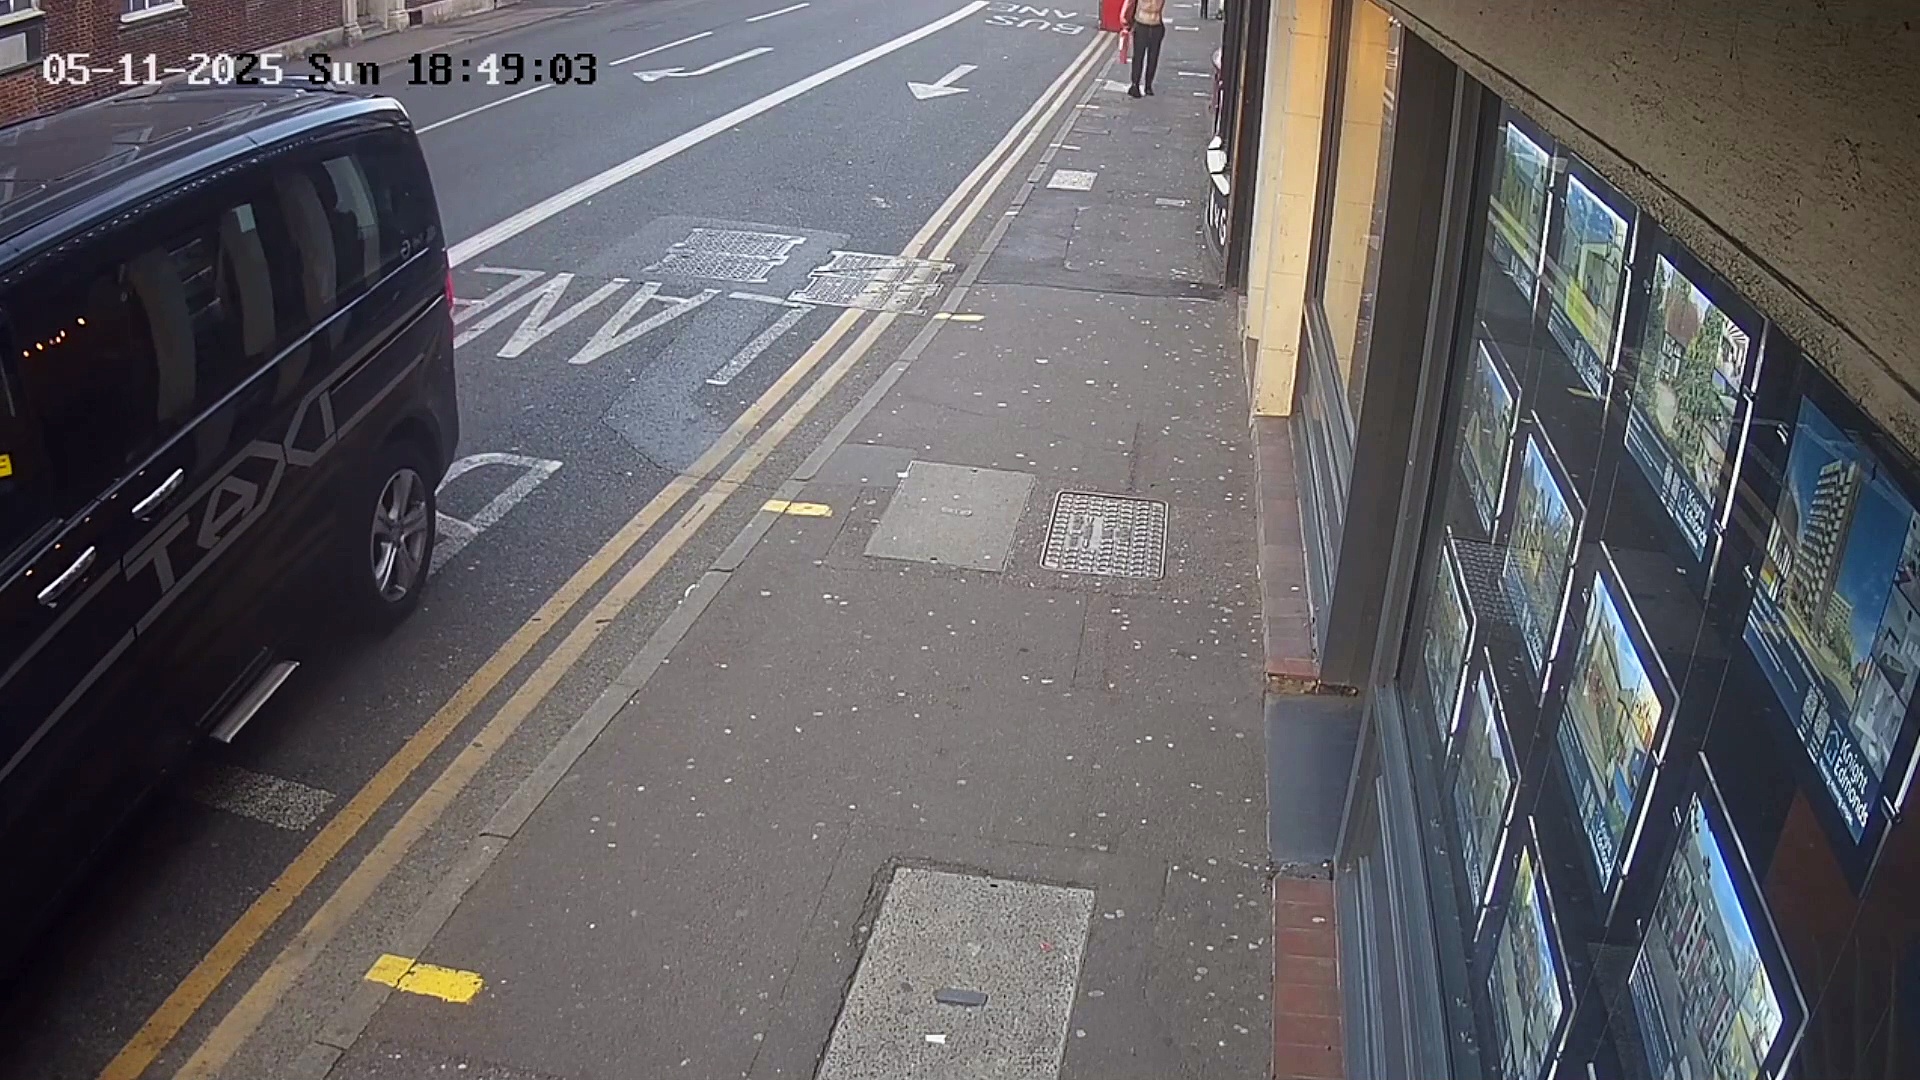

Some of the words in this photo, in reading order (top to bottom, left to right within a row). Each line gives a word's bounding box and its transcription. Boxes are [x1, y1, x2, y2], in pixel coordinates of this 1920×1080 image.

[985, 15, 1084, 34] BUS
[124, 389, 340, 594] TAXI
[1833, 755, 1869, 828] Edmonds
[1840, 737, 1869, 795] Knight
